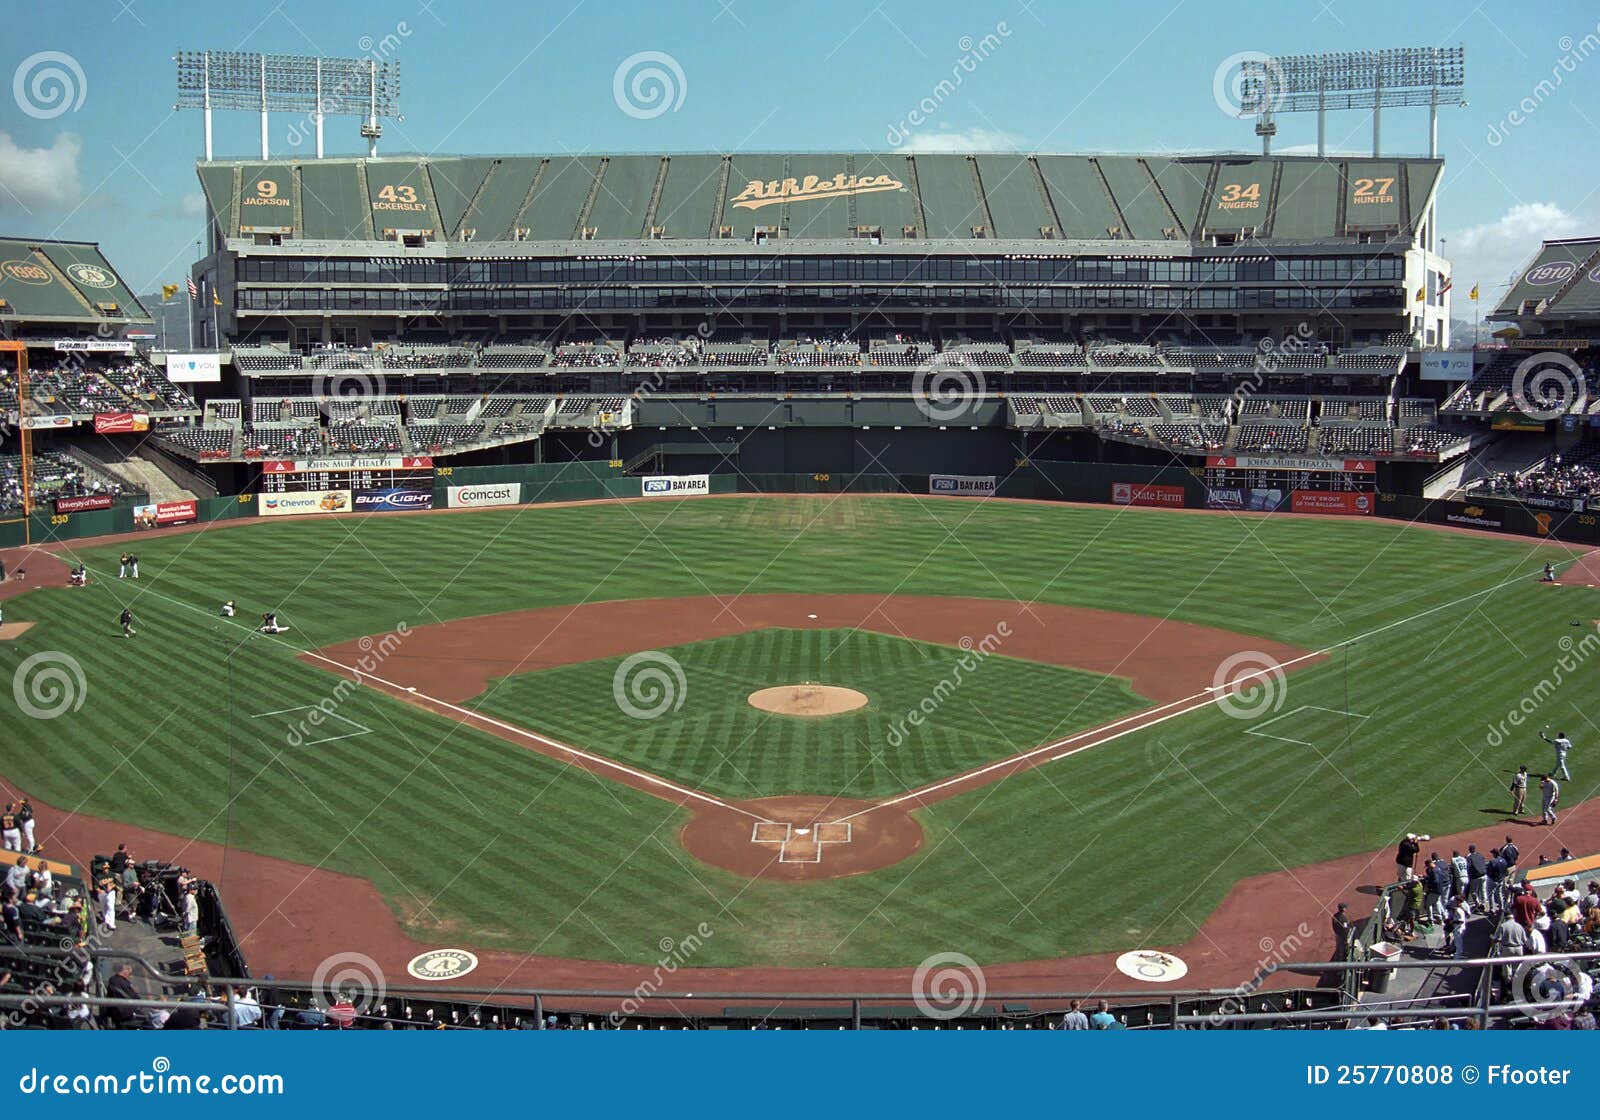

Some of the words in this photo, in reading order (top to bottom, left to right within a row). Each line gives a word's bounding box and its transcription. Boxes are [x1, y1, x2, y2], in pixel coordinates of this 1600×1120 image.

[257, 180, 277, 198] 9
[731, 173, 899, 204] Athletics
[1354, 178, 1394, 196] 27
[378, 185, 417, 202] 43
[1221, 184, 1261, 201] 34
[244, 197, 290, 206] JACKSON
[1218, 201, 1259, 209] FINGERS
[1353, 196, 1393, 204] HUNTER
[373, 202, 427, 211] ECKERSLEY
[7, 265, 49, 279] 1989
[1532, 267, 1571, 279] 1910
[1425, 360, 1439, 368] we
[1451, 361, 1470, 369] you
[673, 481, 687, 490] BAY
[687, 480, 707, 489] AREA
[959, 480, 974, 490] BAY
[974, 481, 994, 490] AREA
[355, 496, 385, 504] BUD
[391, 494, 432, 502] LIGHT
[1132, 488, 1155, 500] State
[1157, 491, 1181, 502] Farm
[59, 500, 84, 510] University
[280, 498, 315, 507] Chevron
[51, 515, 68, 524] 330
[1579, 515, 1595, 525] 330
